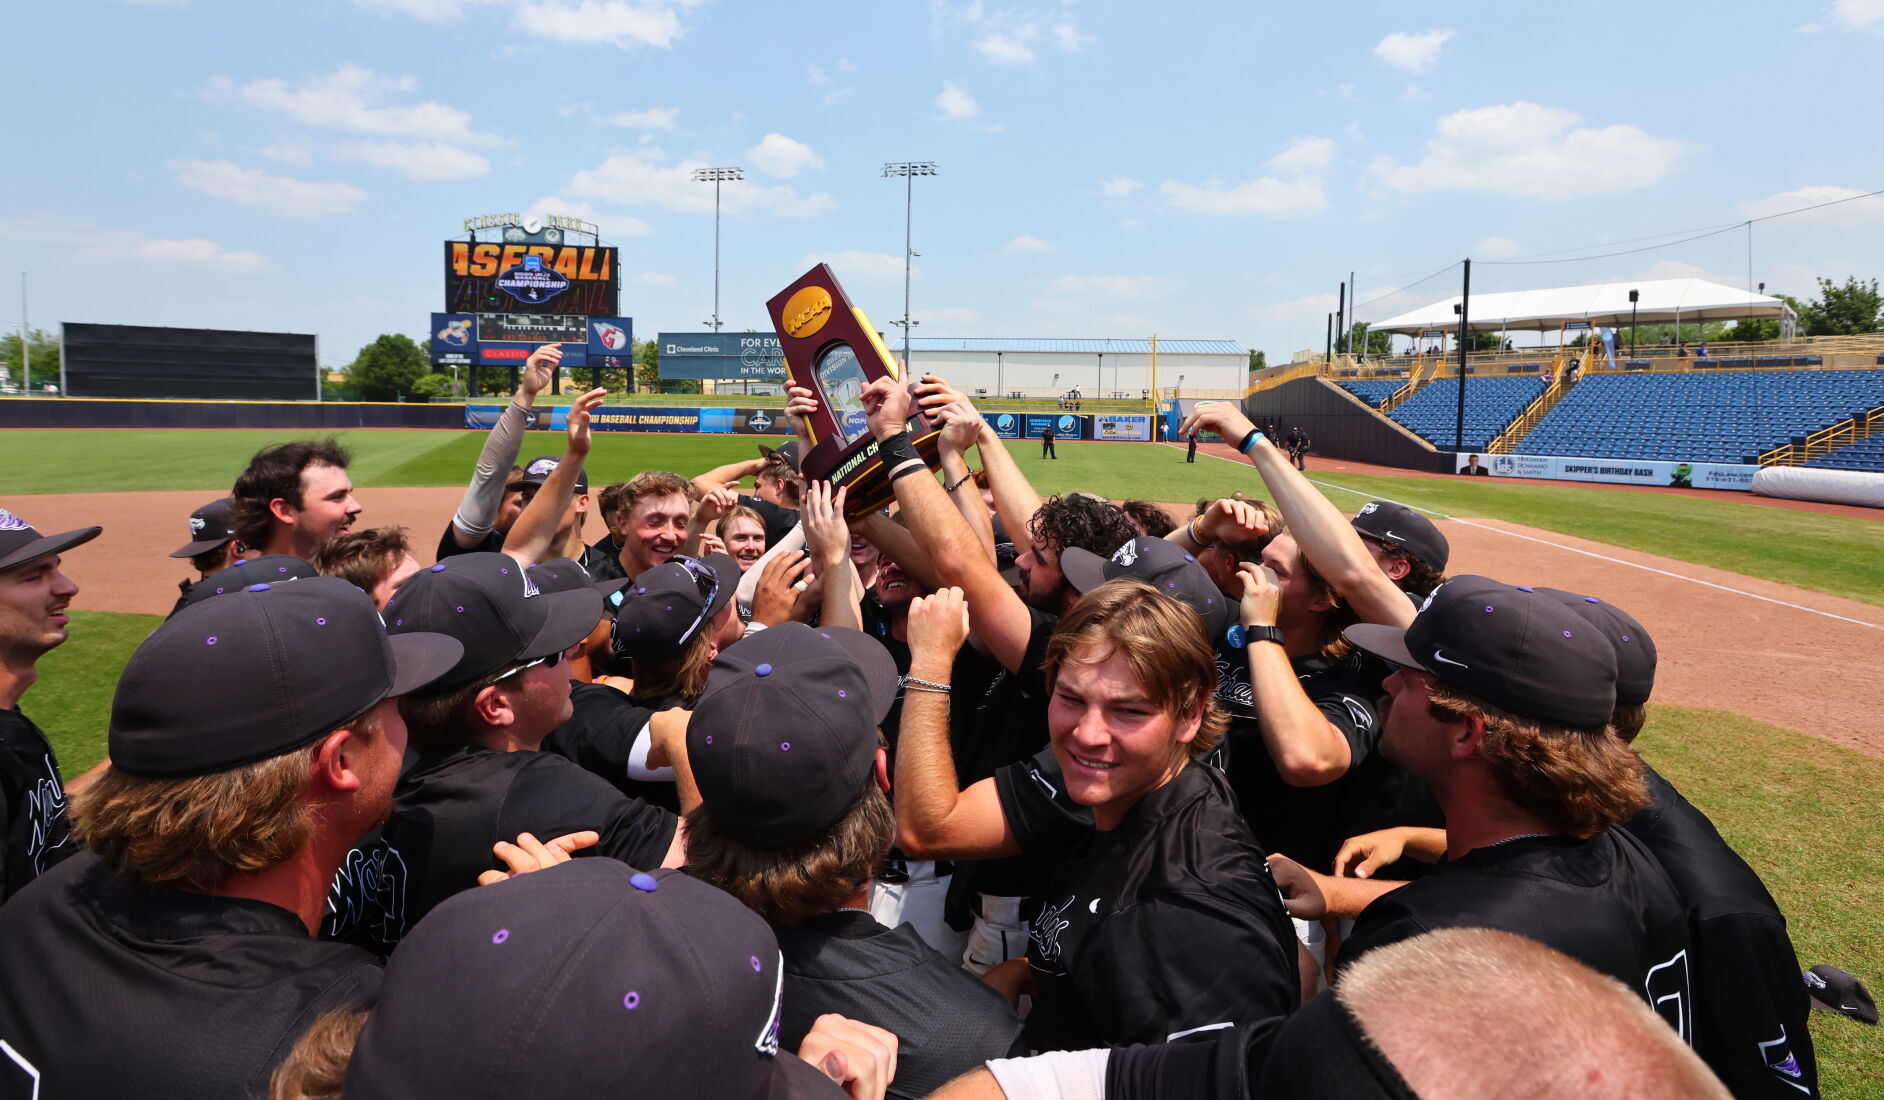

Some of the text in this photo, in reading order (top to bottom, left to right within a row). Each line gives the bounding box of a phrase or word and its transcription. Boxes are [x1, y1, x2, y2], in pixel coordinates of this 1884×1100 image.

[464, 213, 582, 232] CLASSIC PARK
[498, 280, 567, 289] CHAMPIONSHIP
[789, 295, 831, 336] NCAA
[741, 338, 761, 348] FOR
[741, 367, 748, 375] IN
[751, 367, 766, 375] THE
[820, 357, 847, 380] DIVISION
[600, 414, 637, 424] BASEBALL
[639, 415, 698, 425] CHAMPIONSHIP
[831, 451, 867, 485] NATIONAL
[1564, 465, 1653, 477] SKIPPER'S BIRTHDAY BASH
